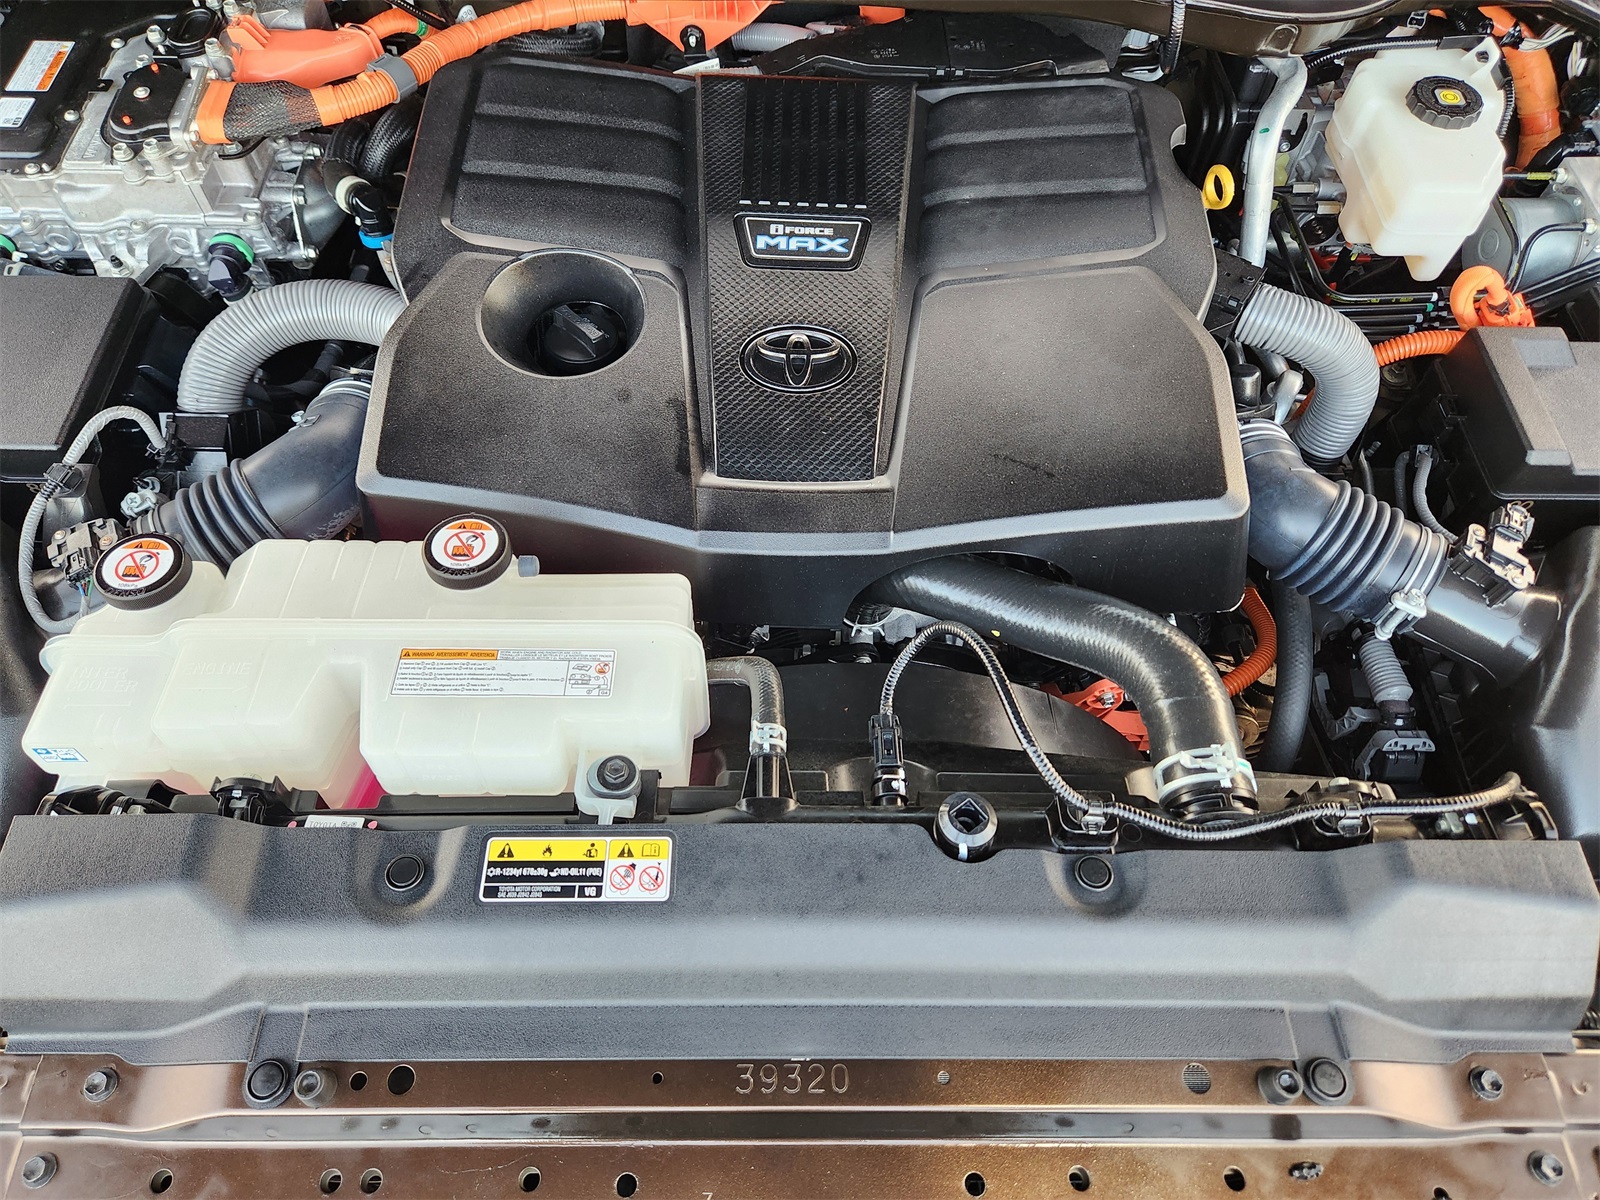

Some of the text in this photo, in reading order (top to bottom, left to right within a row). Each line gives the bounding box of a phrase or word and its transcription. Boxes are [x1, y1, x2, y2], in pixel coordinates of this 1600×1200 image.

[756, 234, 849, 253] MAX
[439, 566, 479, 576] DENSO
[73, 666, 129, 679] INTER
[182, 661, 252, 675] ENGINE
[66, 679, 138, 693] COOLER
[495, 867, 522, 878] R-1234yf
[586, 867, 602, 878] (POE)
[584, 887, 596, 897] VG
[735, 1063, 850, 1094] 39320
